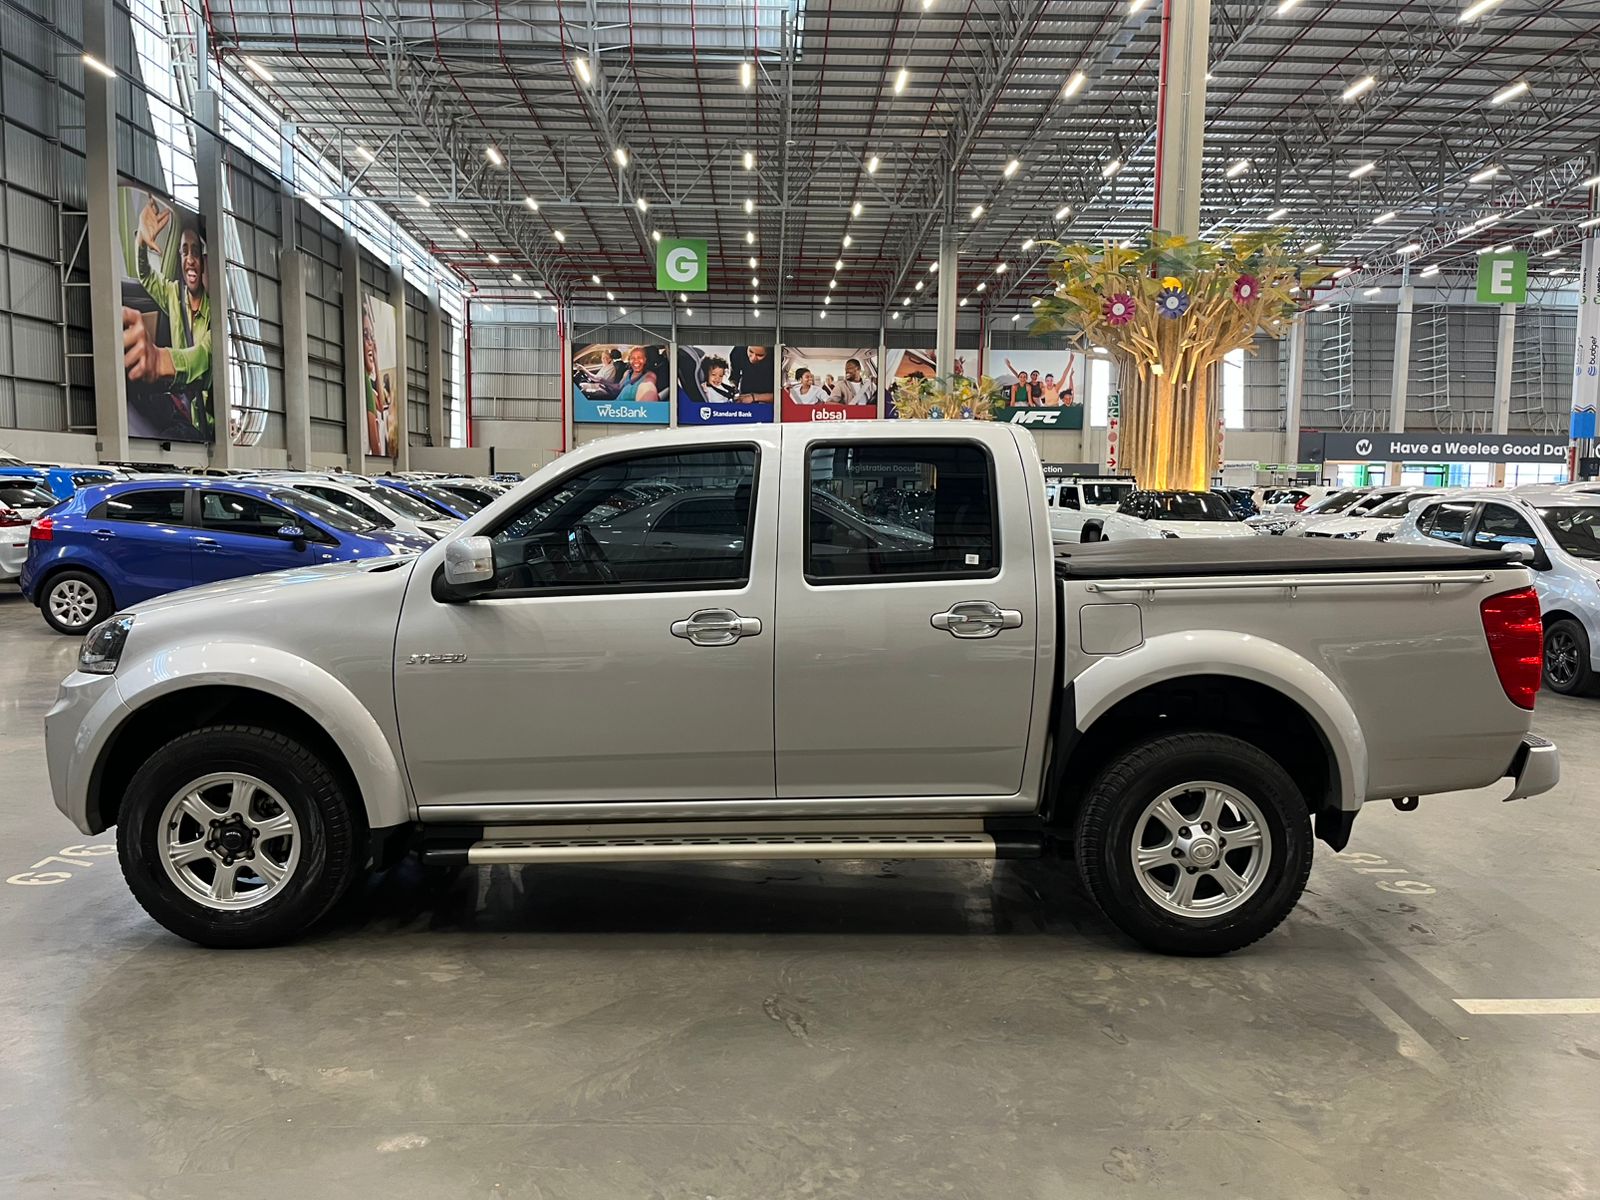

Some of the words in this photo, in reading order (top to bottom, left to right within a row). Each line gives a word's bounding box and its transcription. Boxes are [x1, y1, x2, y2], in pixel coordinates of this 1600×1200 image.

[666, 247, 698, 282] G
[1491, 260, 1514, 294] E
[1588, 336, 1599, 365] budget
[597, 404, 647, 417] WesBank
[1010, 411, 1061, 424] MFC
[1390, 442, 1429, 454] Have
[1431, 444, 1441, 453] a
[1445, 442, 1499, 454] Weelee
[1502, 443, 1541, 455] Good
[1042, 465, 1063, 473] ction
[405, 653, 468, 665] STEED
